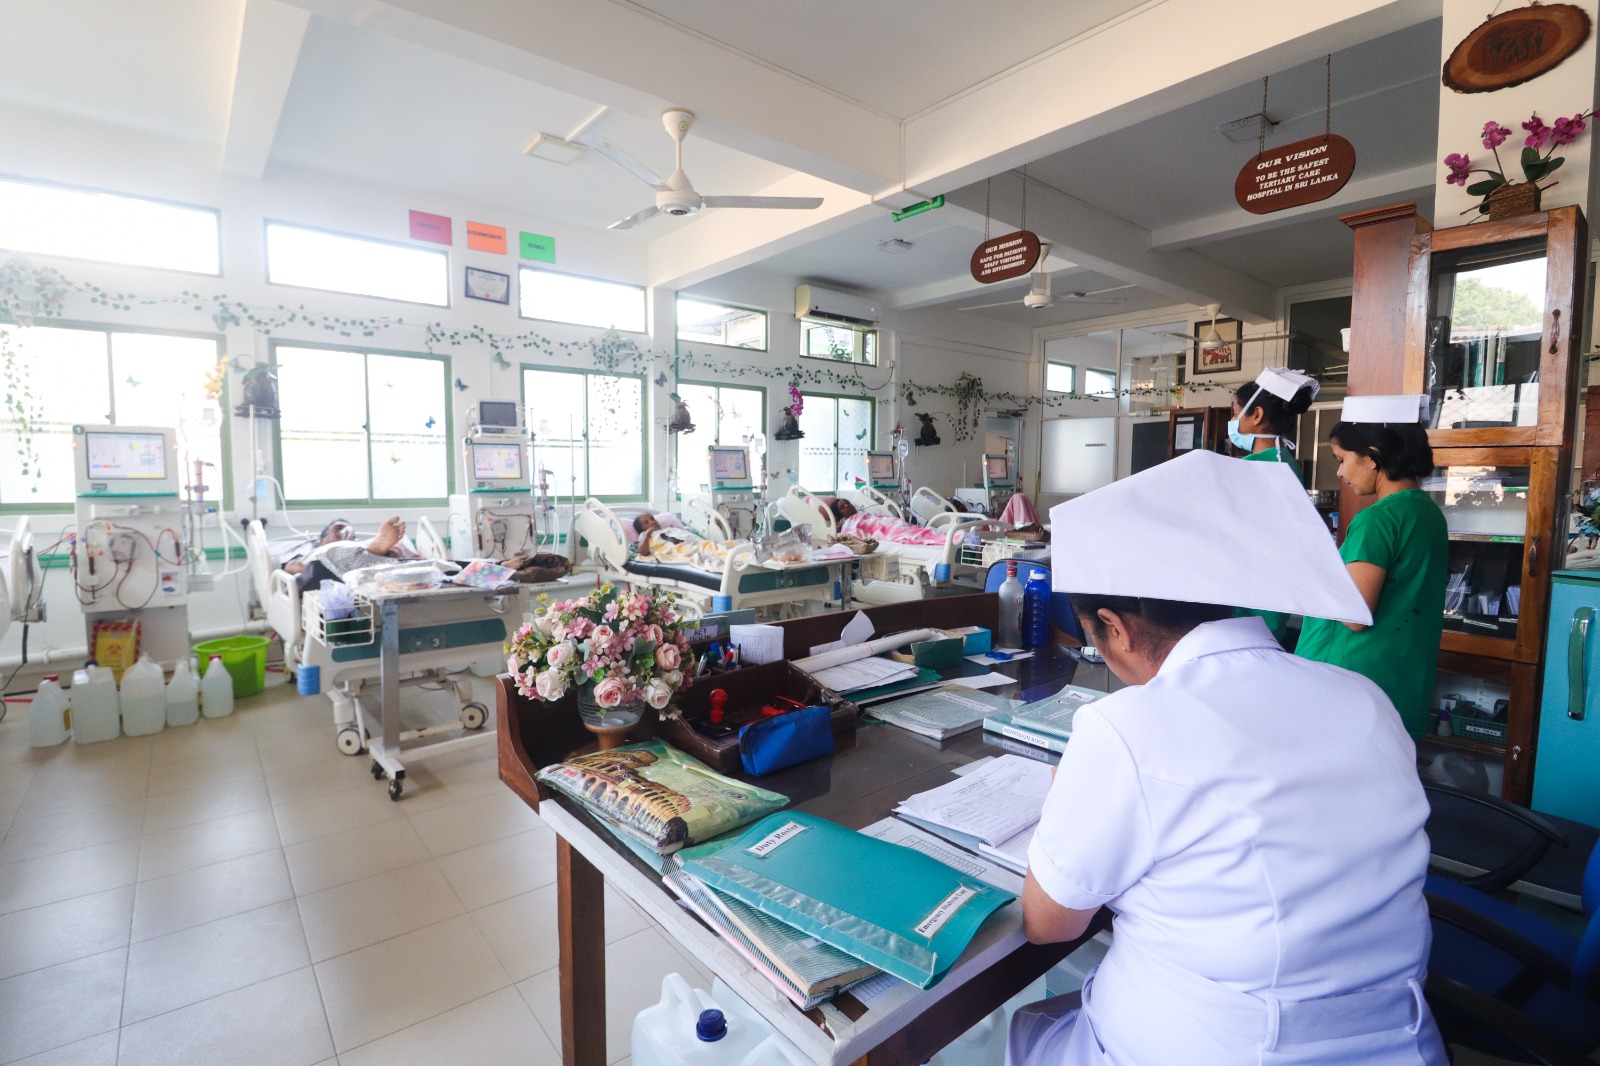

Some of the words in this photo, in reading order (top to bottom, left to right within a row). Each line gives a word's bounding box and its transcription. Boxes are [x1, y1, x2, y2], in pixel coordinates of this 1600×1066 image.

[1257, 158, 1281, 170] OUR
[1286, 145, 1328, 162] VISION
[1268, 171, 1278, 179] BE
[1280, 166, 1295, 176] THE
[1298, 158, 1329, 171] SAFEST
[1247, 187, 1282, 201] HOSPITAL
[1284, 184, 1293, 192] IN
[1294, 180, 1308, 189] SRI
[1310, 173, 1338, 185] LANKA
[1260, 174, 1296, 189] TERTIARY
[1299, 169, 1320, 180] CARE
[993, 252, 1003, 260] FOR
[1003, 246, 1027, 257] PATIENTS
[998, 238, 1023, 250] MISSION
[1000, 254, 1022, 264] VISITORS
[432, 638, 440, 647] 3
[1003, 727, 1030, 741] ADMISSION
[1031, 738, 1046, 746] BOOK
[755, 838, 777, 852] Duty
[773, 824, 799, 840] Roster
[917, 910, 945, 933] Emergency
